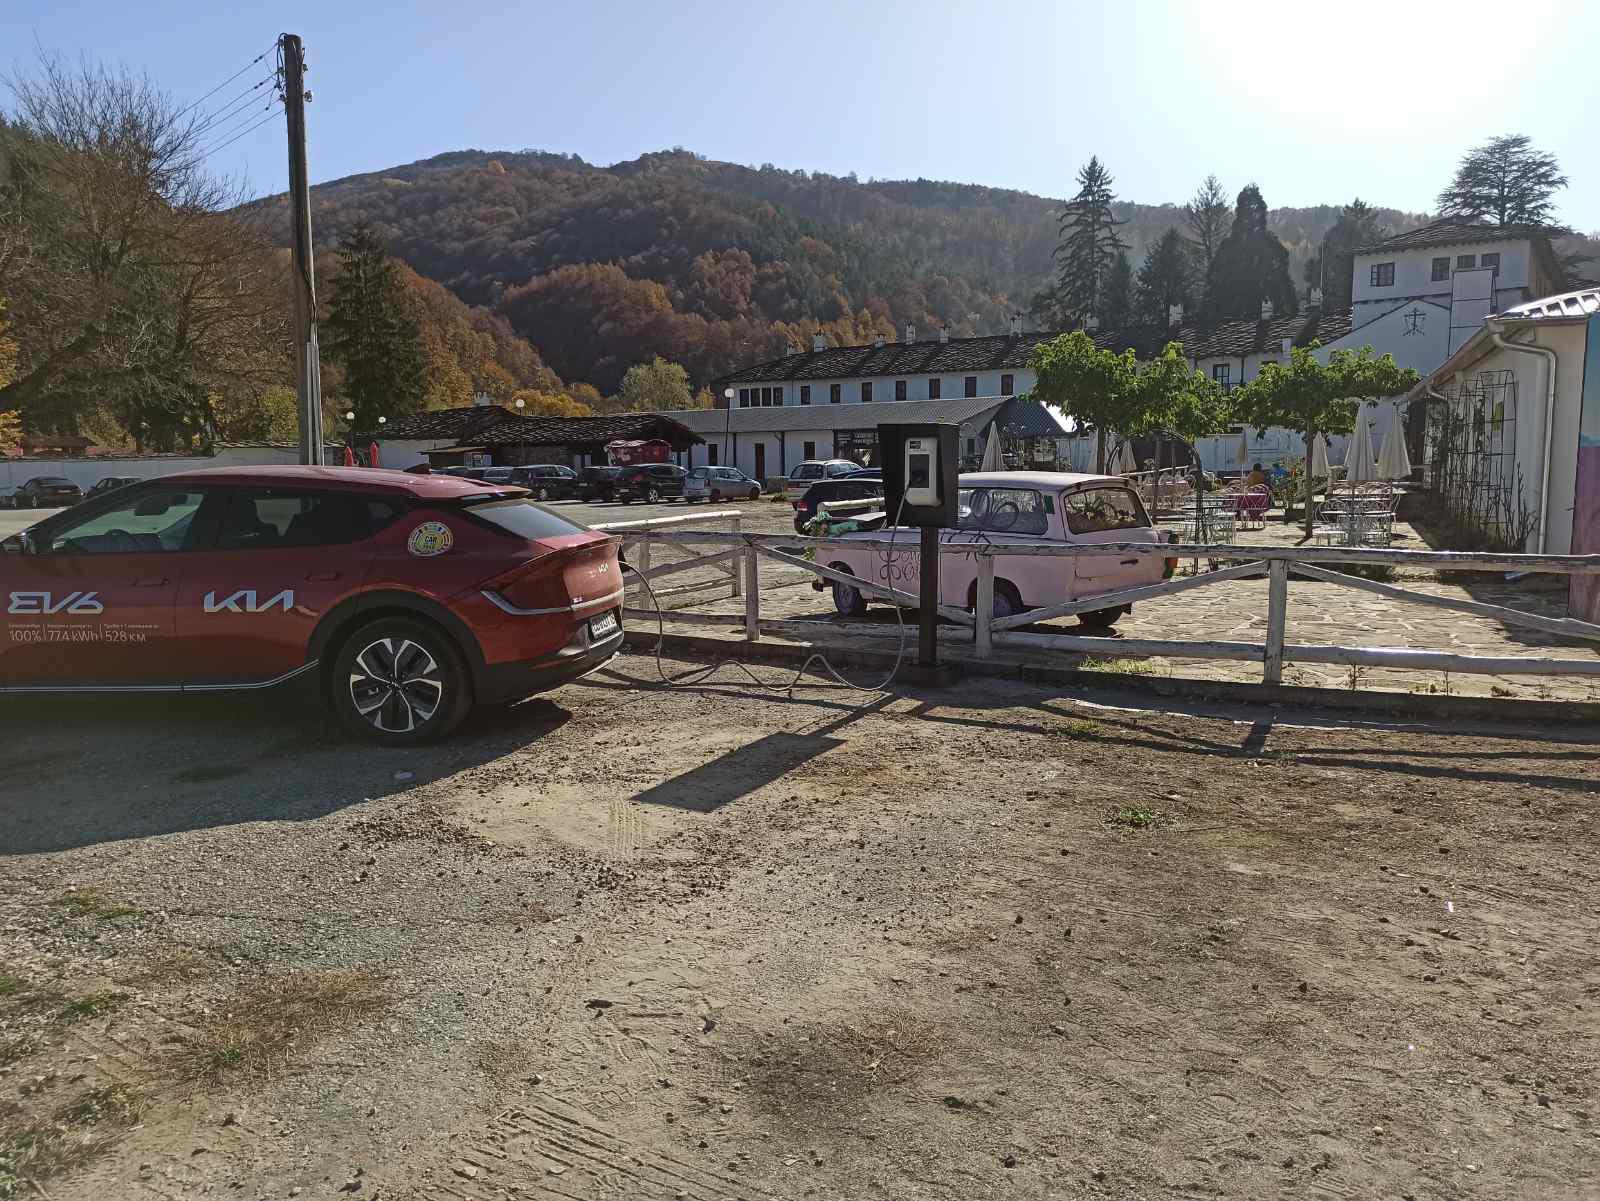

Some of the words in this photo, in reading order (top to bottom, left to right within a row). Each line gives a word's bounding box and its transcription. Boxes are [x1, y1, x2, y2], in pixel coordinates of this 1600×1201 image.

[7, 591, 104, 614] EV6
[203, 589, 294, 612] KIA
[10, 630, 42, 641] 100%
[105, 630, 127, 642] 528
